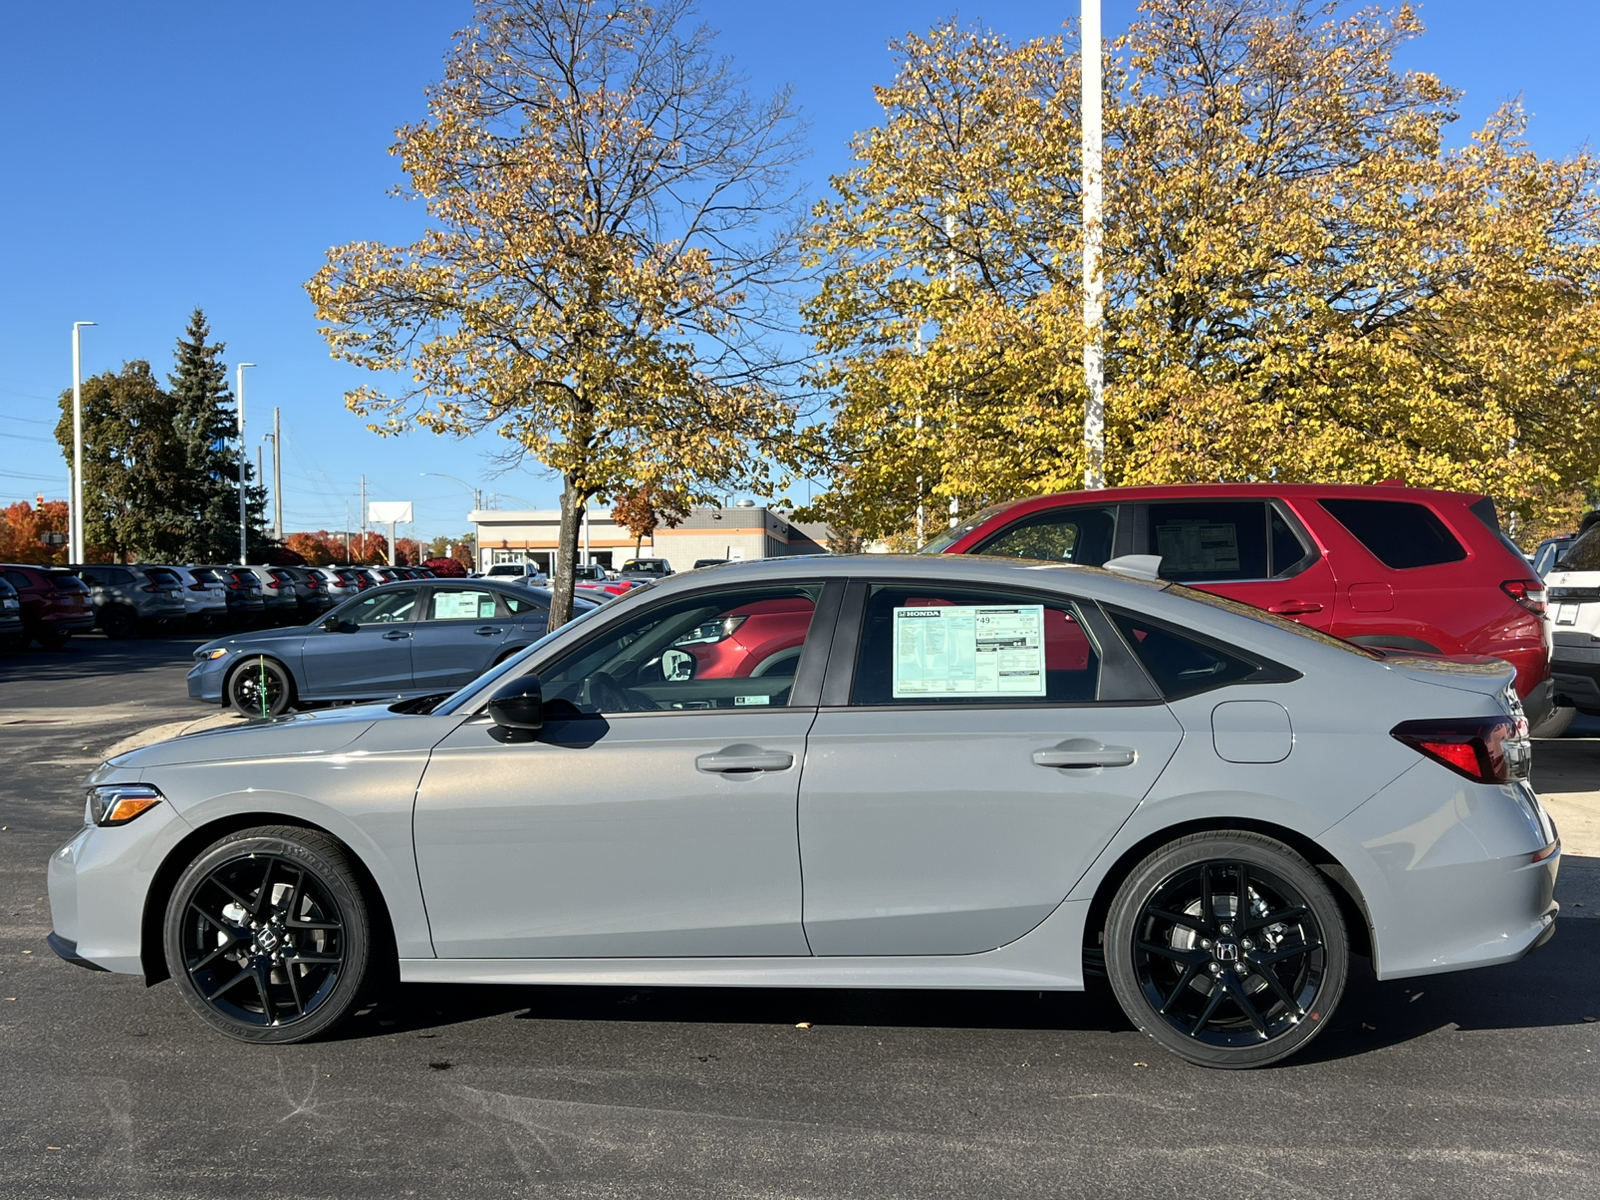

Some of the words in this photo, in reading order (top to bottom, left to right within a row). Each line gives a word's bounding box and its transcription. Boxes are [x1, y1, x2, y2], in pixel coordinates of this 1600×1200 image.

[980, 616, 990, 624] 49
[277, 844, 341, 890] ASSURANCE
[1143, 847, 1217, 889] ASSURANCE
